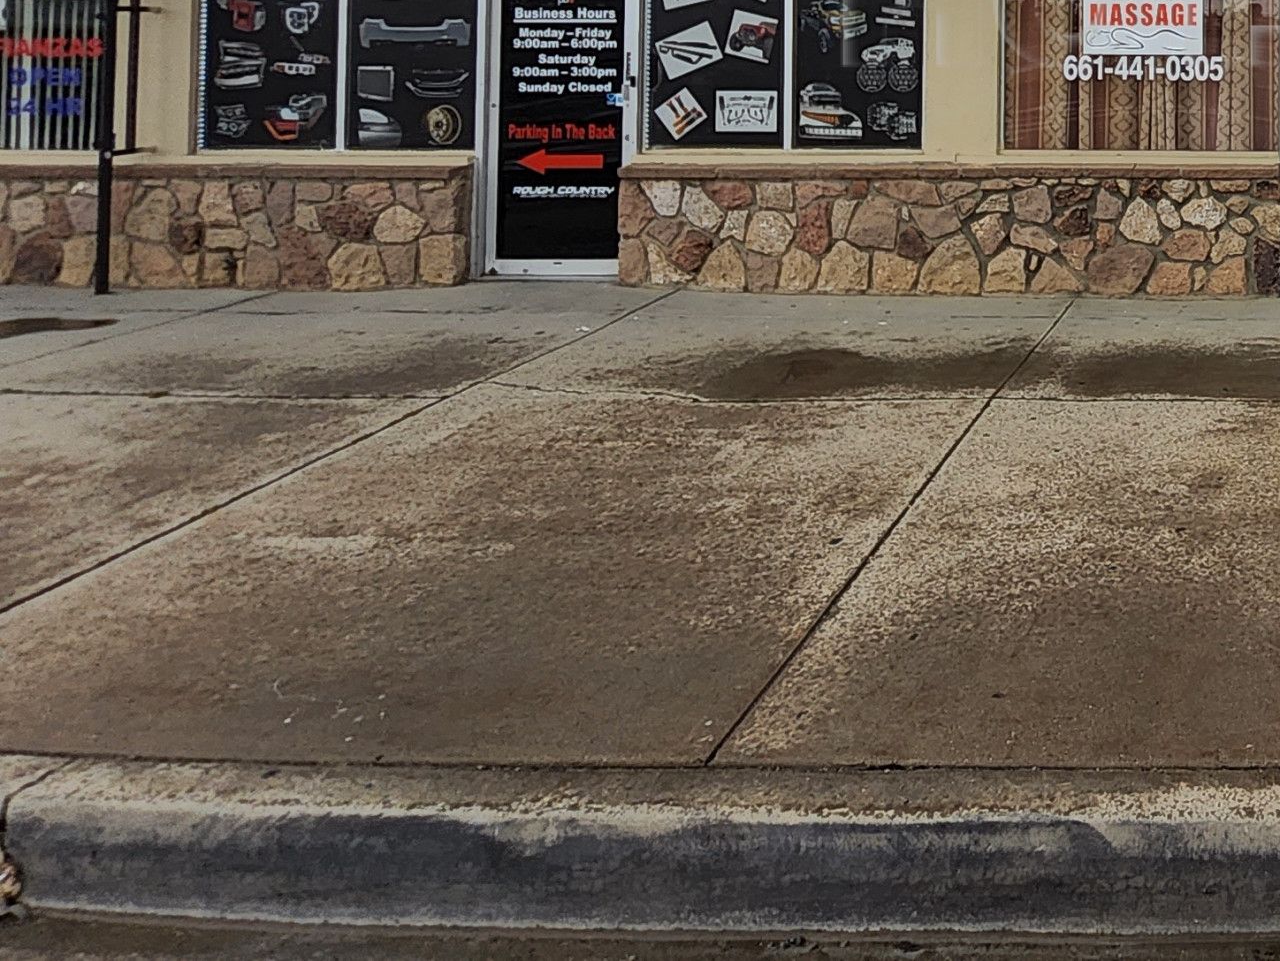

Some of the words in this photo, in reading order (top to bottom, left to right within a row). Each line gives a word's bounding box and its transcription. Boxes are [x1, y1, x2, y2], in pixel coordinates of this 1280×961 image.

[514, 7, 573, 19] Business
[577, 7, 616, 19] Hours
[1090, 3, 1197, 26] MASSAGE
[519, 28, 565, 40] Monday
[575, 28, 612, 40] Friday
[513, 39, 559, 49] 9:00am
[571, 39, 617, 50] 6:00pm
[538, 54, 596, 66] Saturday
[512, 67, 559, 77] 9:00am
[570, 67, 616, 78] 3:00pm
[1063, 56, 1223, 81] 661-441-0305
[518, 82, 565, 95] Sunday
[568, 82, 612, 93] Closed
[509, 124, 549, 143] Parking
[565, 124, 585, 139] The
[588, 124, 615, 139] Back
[513, 186, 554, 195] ROUGH
[557, 186, 615, 195] COUNTRY
